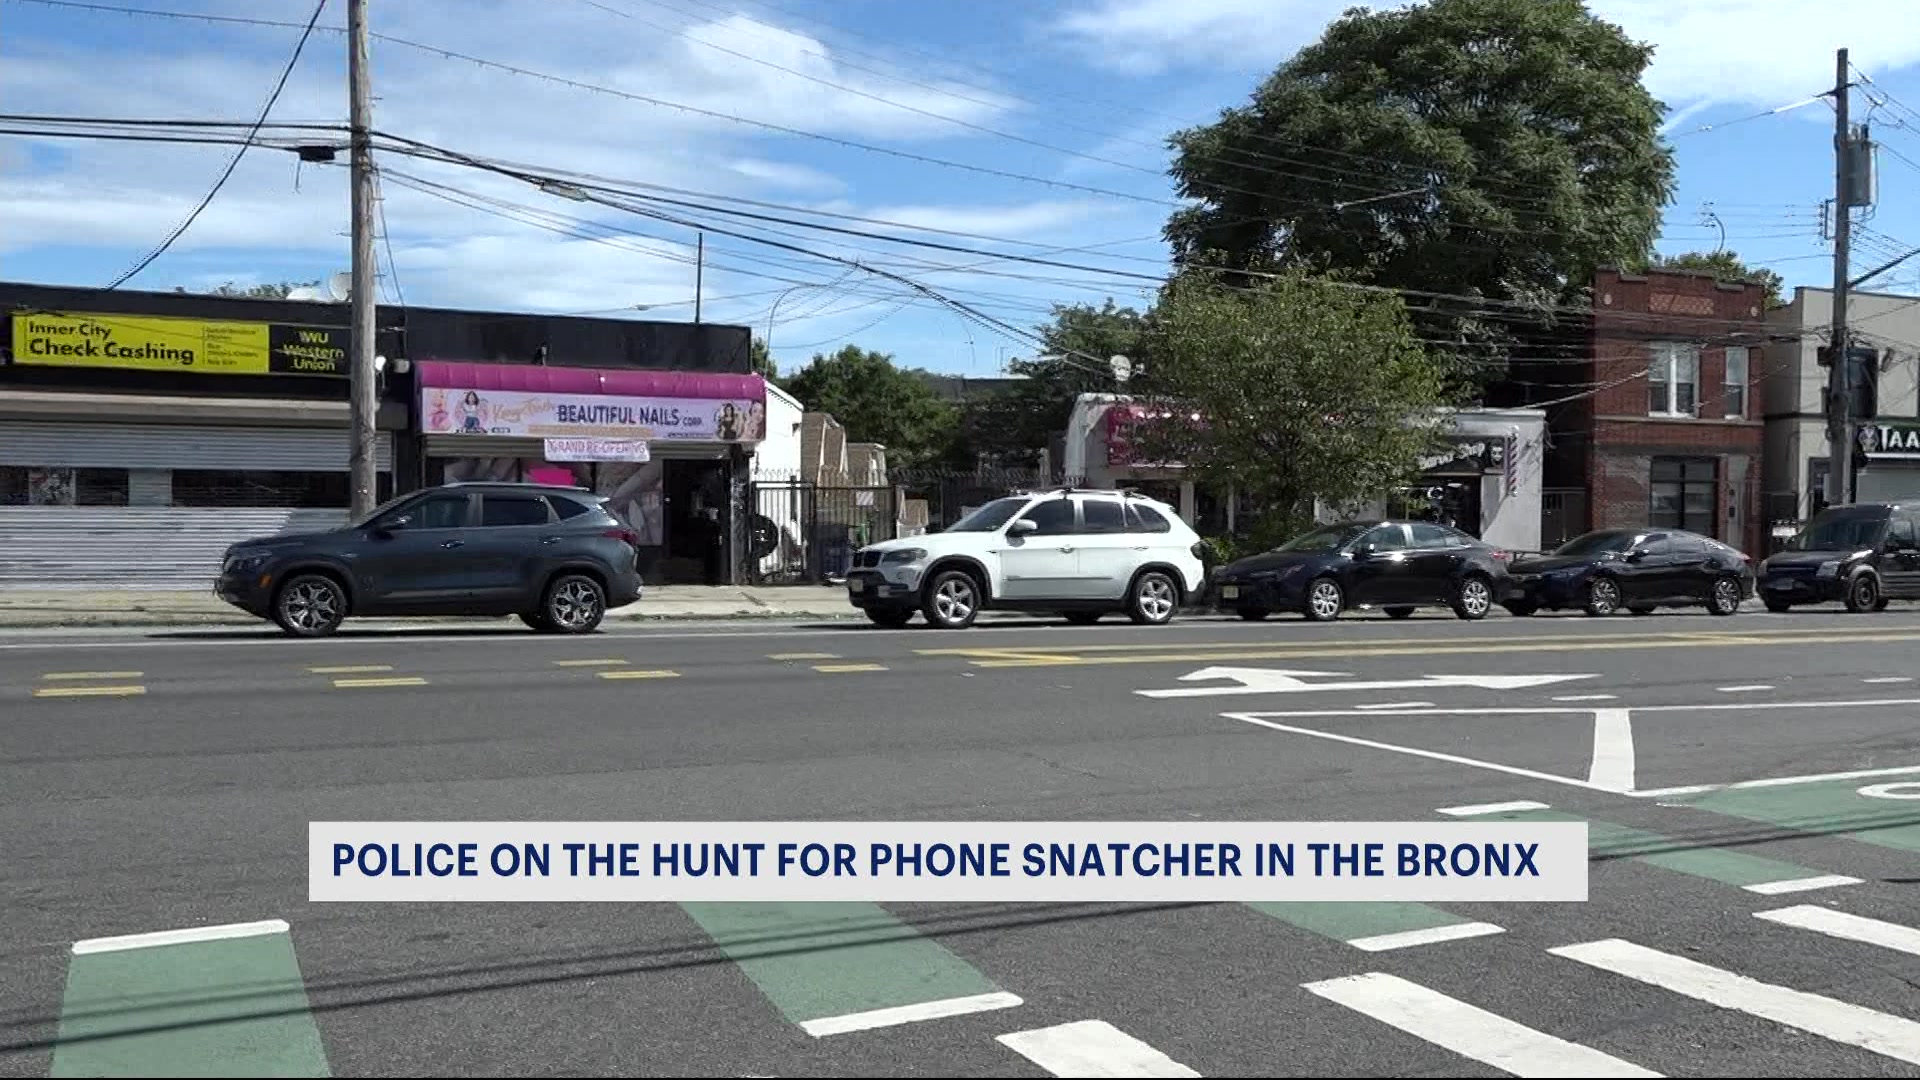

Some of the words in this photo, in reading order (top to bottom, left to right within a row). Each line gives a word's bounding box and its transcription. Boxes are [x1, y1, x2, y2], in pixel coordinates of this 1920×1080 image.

[29, 321, 75, 335] Inner
[79, 323, 112, 340] City
[29, 338, 100, 357] Check
[104, 342, 194, 365] Cashing
[283, 343, 345, 360] Western
[293, 358, 336, 371] Union
[557, 404, 636, 426] BEAUTIFUL
[639, 407, 680, 427] NAILS
